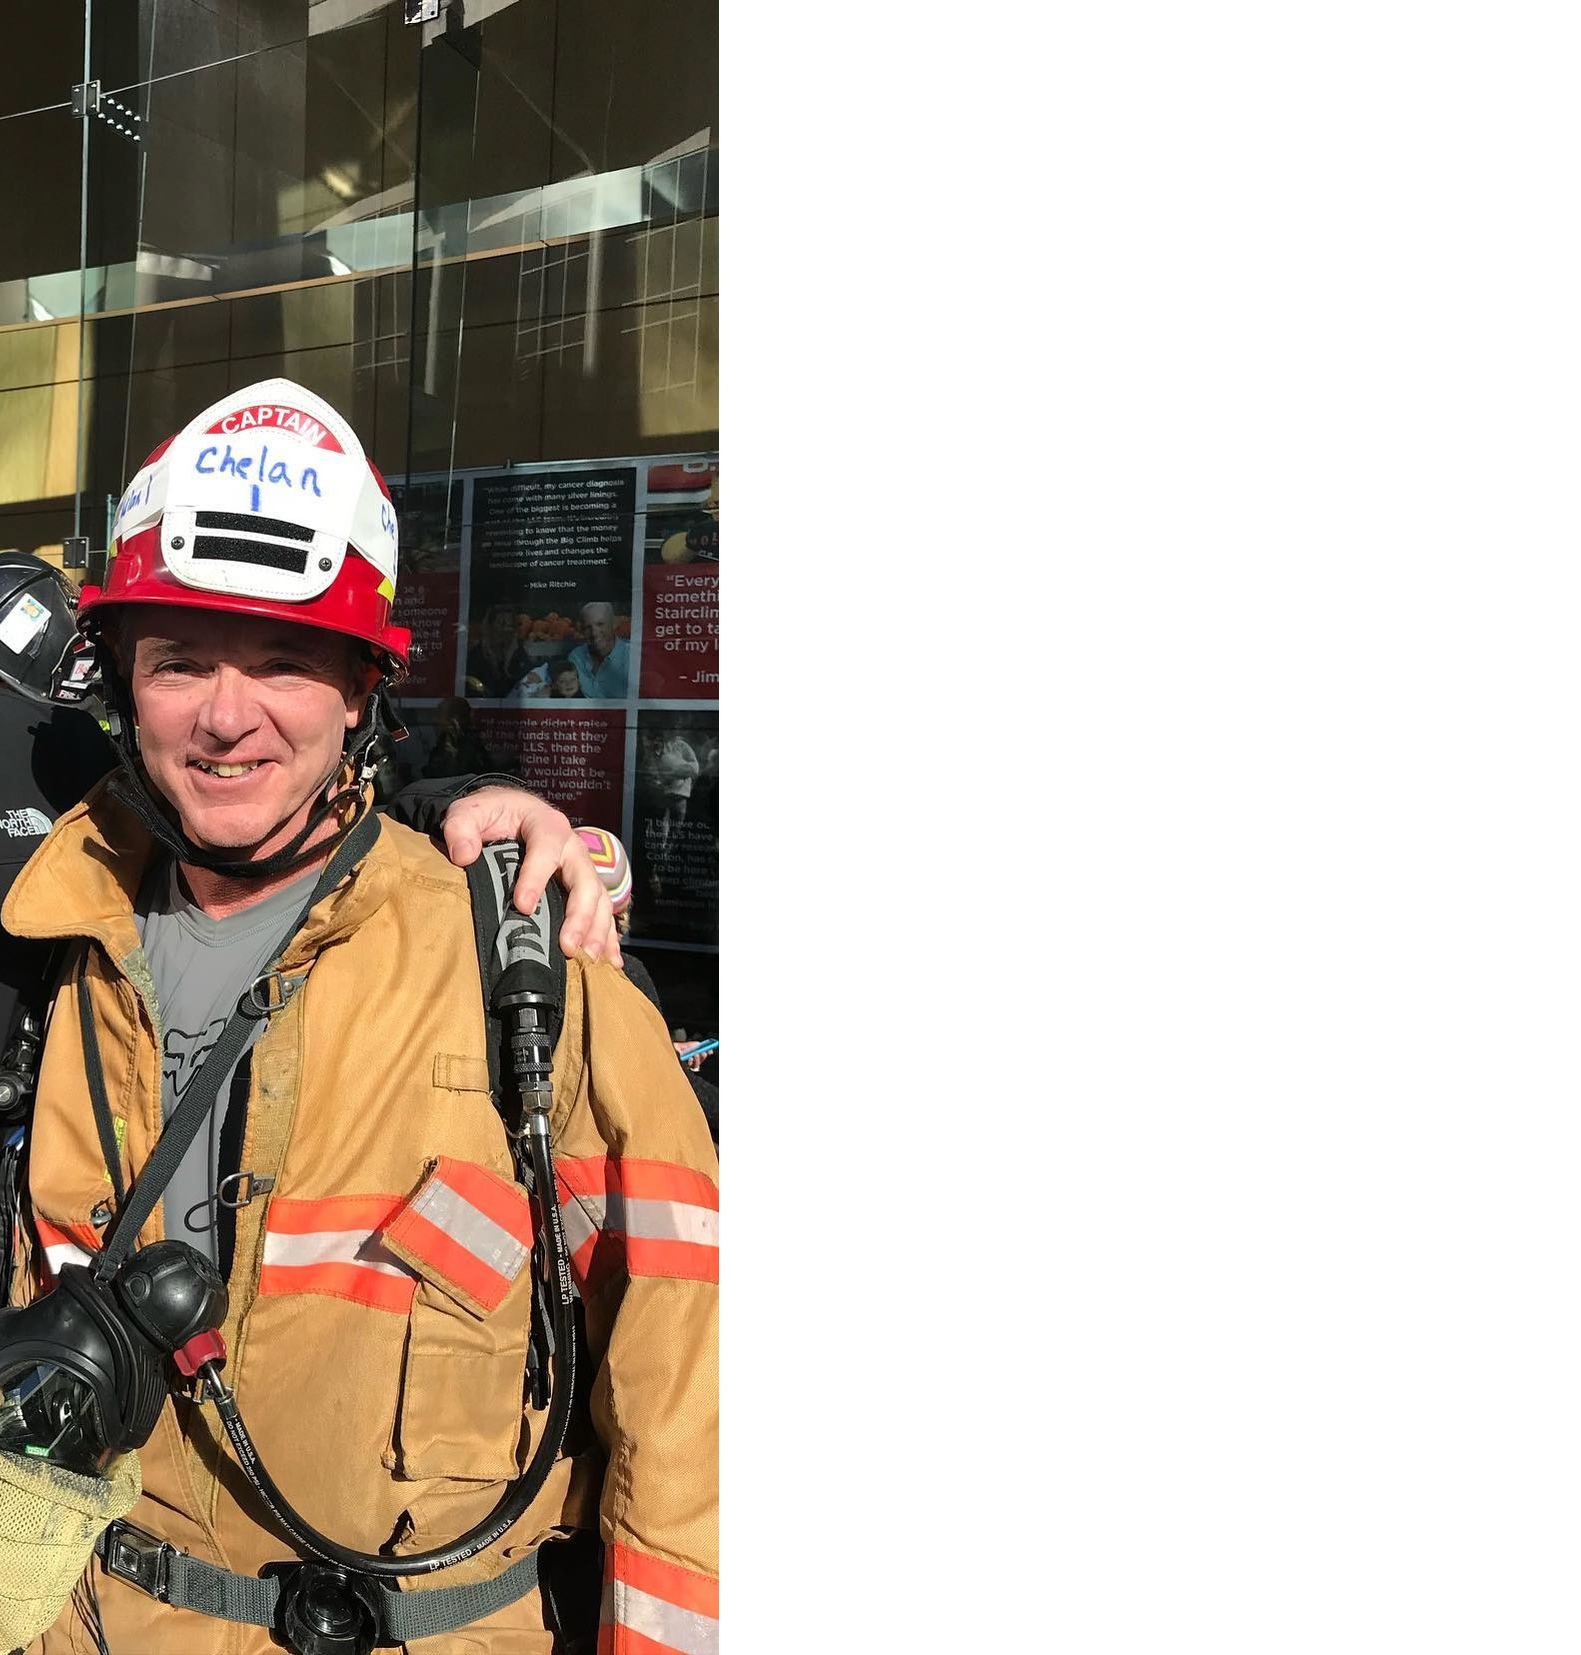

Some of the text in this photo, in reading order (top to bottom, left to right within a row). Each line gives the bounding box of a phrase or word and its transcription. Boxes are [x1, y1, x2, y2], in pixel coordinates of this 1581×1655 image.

[221, 406, 326, 442] CAPTAIN
[195, 445, 322, 497] Chelan
[586, 480, 624, 488] diagnosis
[530, 504, 560, 513] biggest
[570, 502, 610, 510] becoming
[526, 528, 534, 536] to
[590, 525, 618, 533] money
[560, 536, 574, 545] Big
[576, 536, 598, 544] Climb
[526, 548, 543, 557] lives
[560, 547, 594, 556] changes
[530, 581, 548, 589] Mike
[549, 580, 576, 588] Ritchie
[412, 618, 442, 628] know
[654, 624, 682, 638] get
[686, 623, 702, 635] to
[664, 640, 682, 652] of
[686, 641, 709, 654] my
[691, 670, 719, 683] Jim
[518, 730, 550, 741] funds
[553, 731, 577, 741] that
[581, 731, 608, 744] they
[523, 744, 548, 753] LLS,
[551, 743, 578, 753] then
[581, 743, 601, 753] the
[560, 754, 586, 764] take
[534, 766, 586, 777] wouldn't
[589, 768, 606, 778] be
[526, 778, 548, 788] and
[558, 778, 612, 790] wouldn't
[6, 810, 28, 818] THE
[8, 826, 36, 838] FACE
[688, 830, 714, 842] have
[550, 1204, 559, 1226] U.S.A.
[555, 1234, 563, 1252] MADE
[558, 1258, 568, 1292] TESTED
[562, 1294, 570, 1305] LP
[226, 1420, 234, 1430] DO
[231, 1430, 239, 1442] NOT
[236, 1442, 249, 1466] EXCEED
[236, 1422, 246, 1440] MADE
[246, 1446, 256, 1464] U.S.A.
[430, 1562, 440, 1570] LP
[441, 1549, 472, 1566] TESTED
[476, 1536, 494, 1550] MADE
[498, 1518, 514, 1533] U.S.A.
